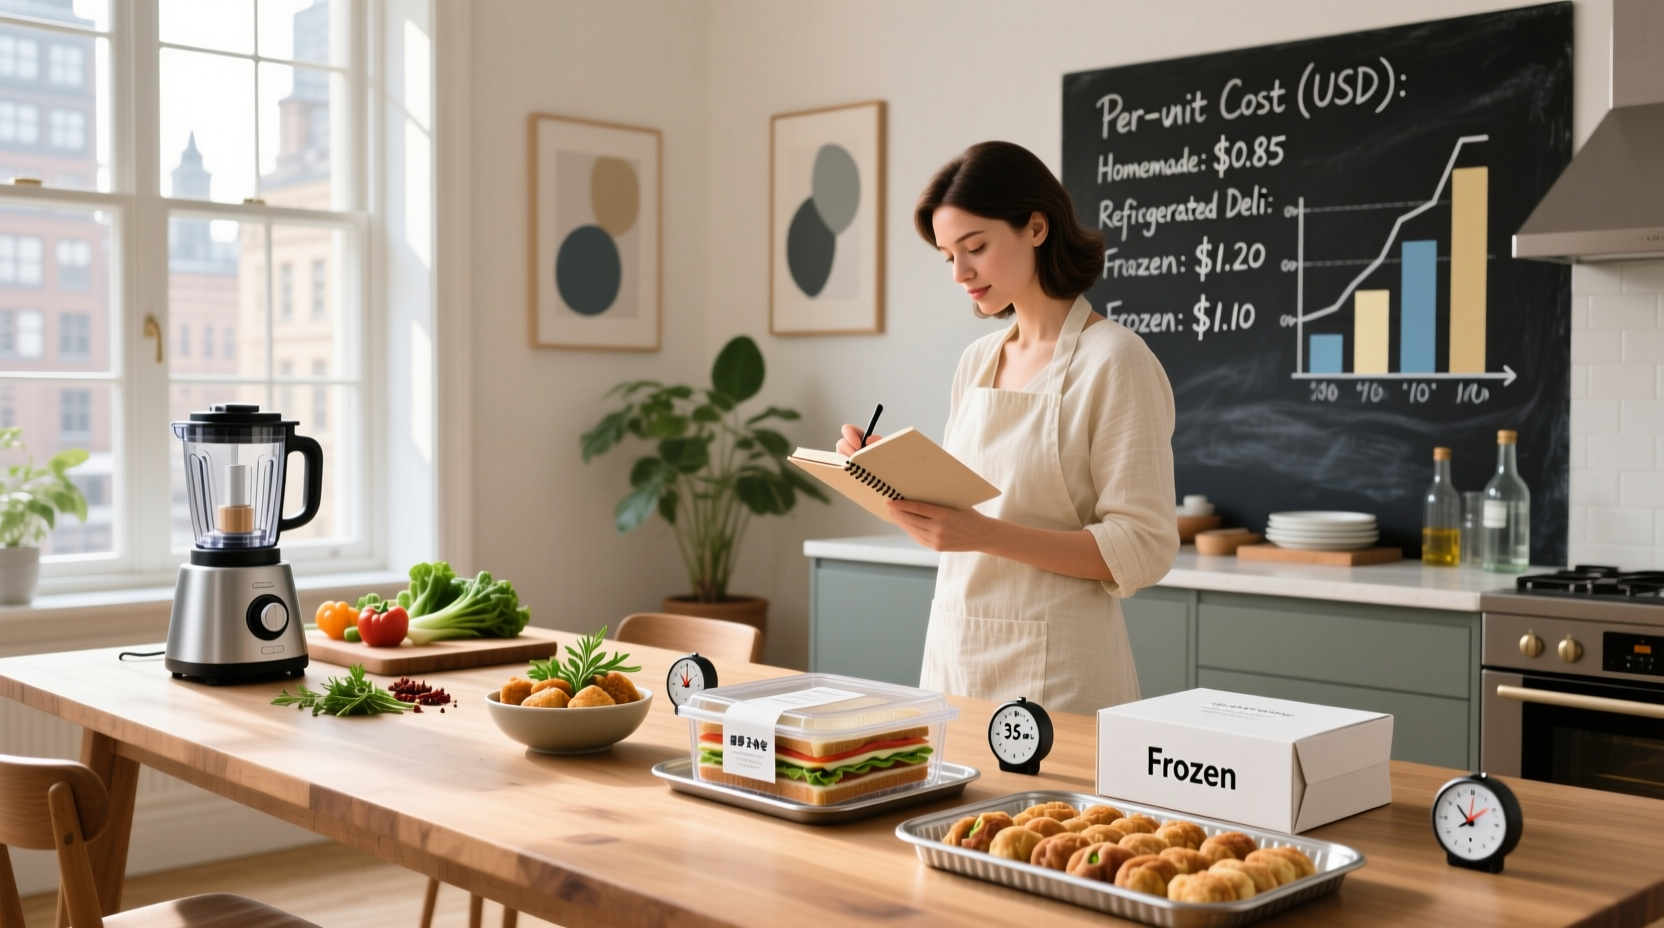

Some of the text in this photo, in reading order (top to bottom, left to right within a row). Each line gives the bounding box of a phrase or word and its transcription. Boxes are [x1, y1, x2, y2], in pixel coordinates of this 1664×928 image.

[1219, 78, 1286, 120] Cost
[1297, 56, 1407, 120] (USD):
[1097, 134, 1286, 184] Homemade: $0.85
[1225, 184, 1273, 219] Deli:
[1195, 236, 1266, 282] $1.20
[1192, 293, 1256, 341] $1.10
[1148, 746, 1236, 790] Frozen
